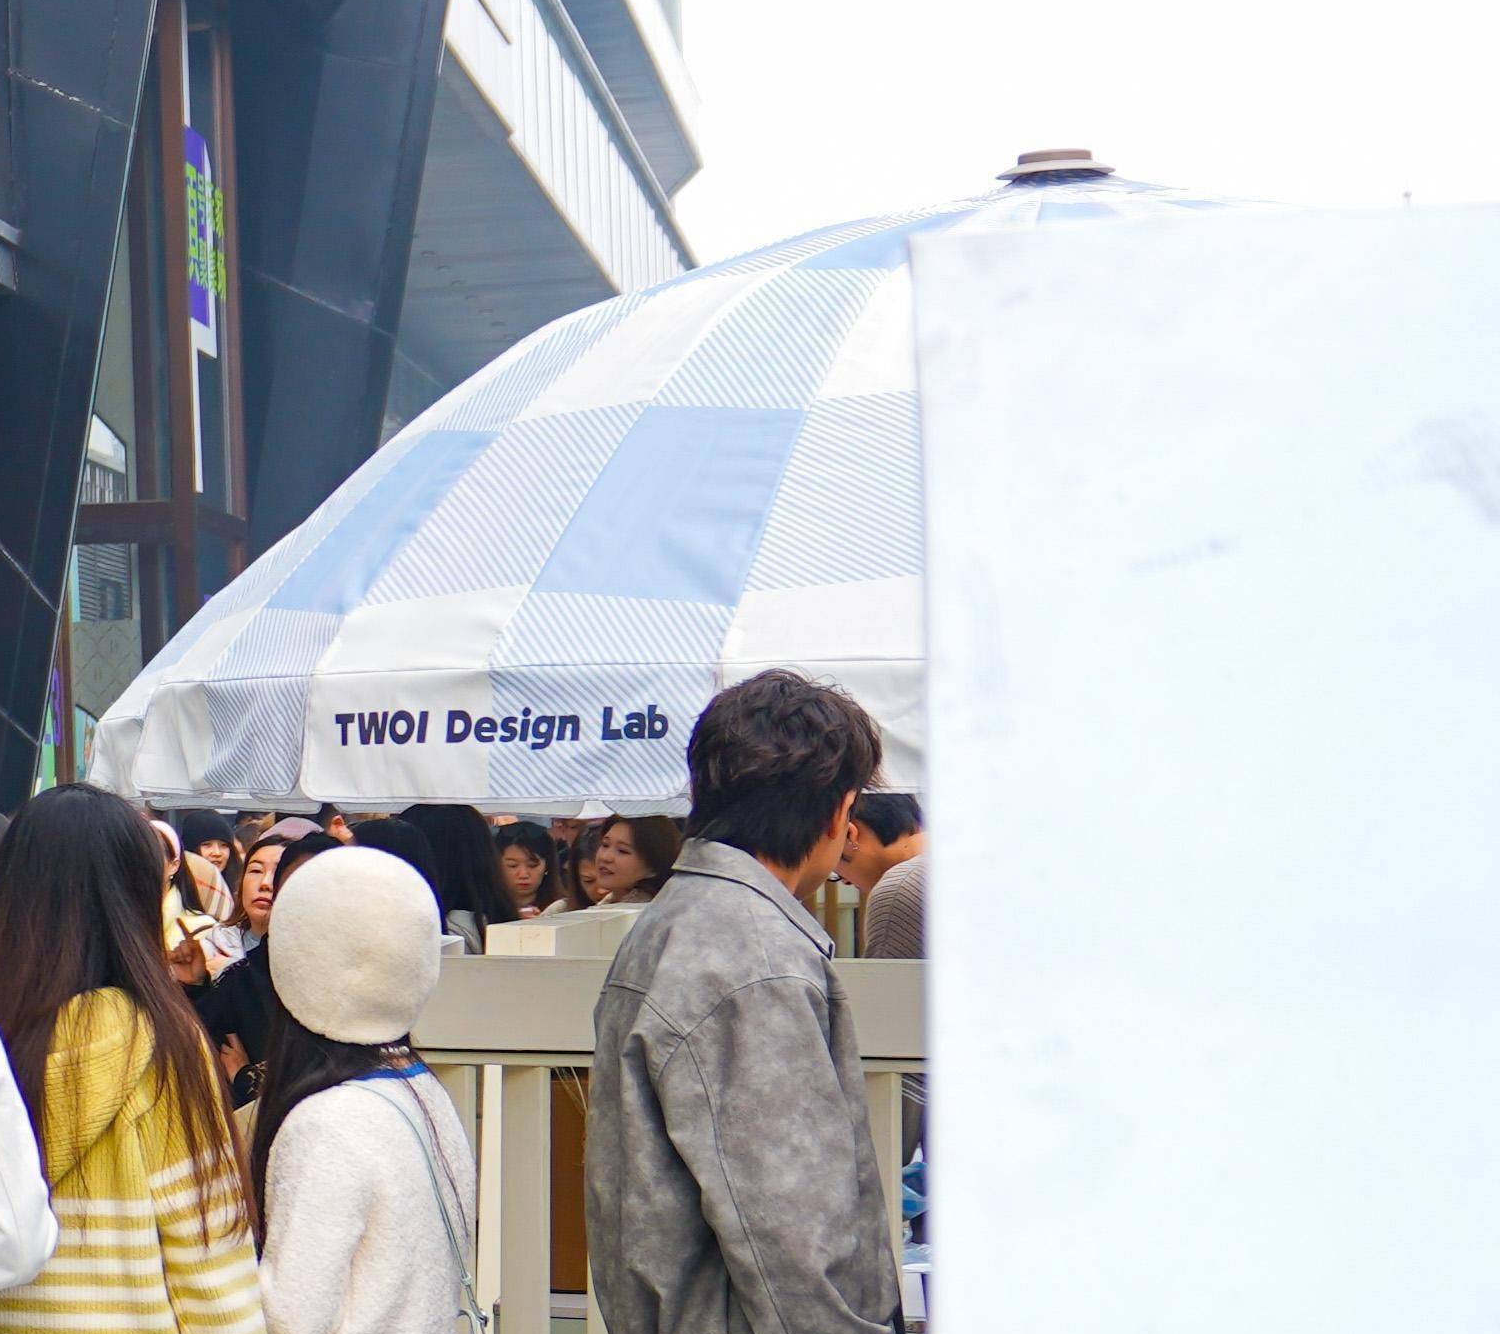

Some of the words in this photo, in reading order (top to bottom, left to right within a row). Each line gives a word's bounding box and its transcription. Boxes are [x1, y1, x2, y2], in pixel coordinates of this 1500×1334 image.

[335, 710, 429, 746] TWOI
[446, 707, 581, 750] Design
[601, 705, 669, 741] Lab
